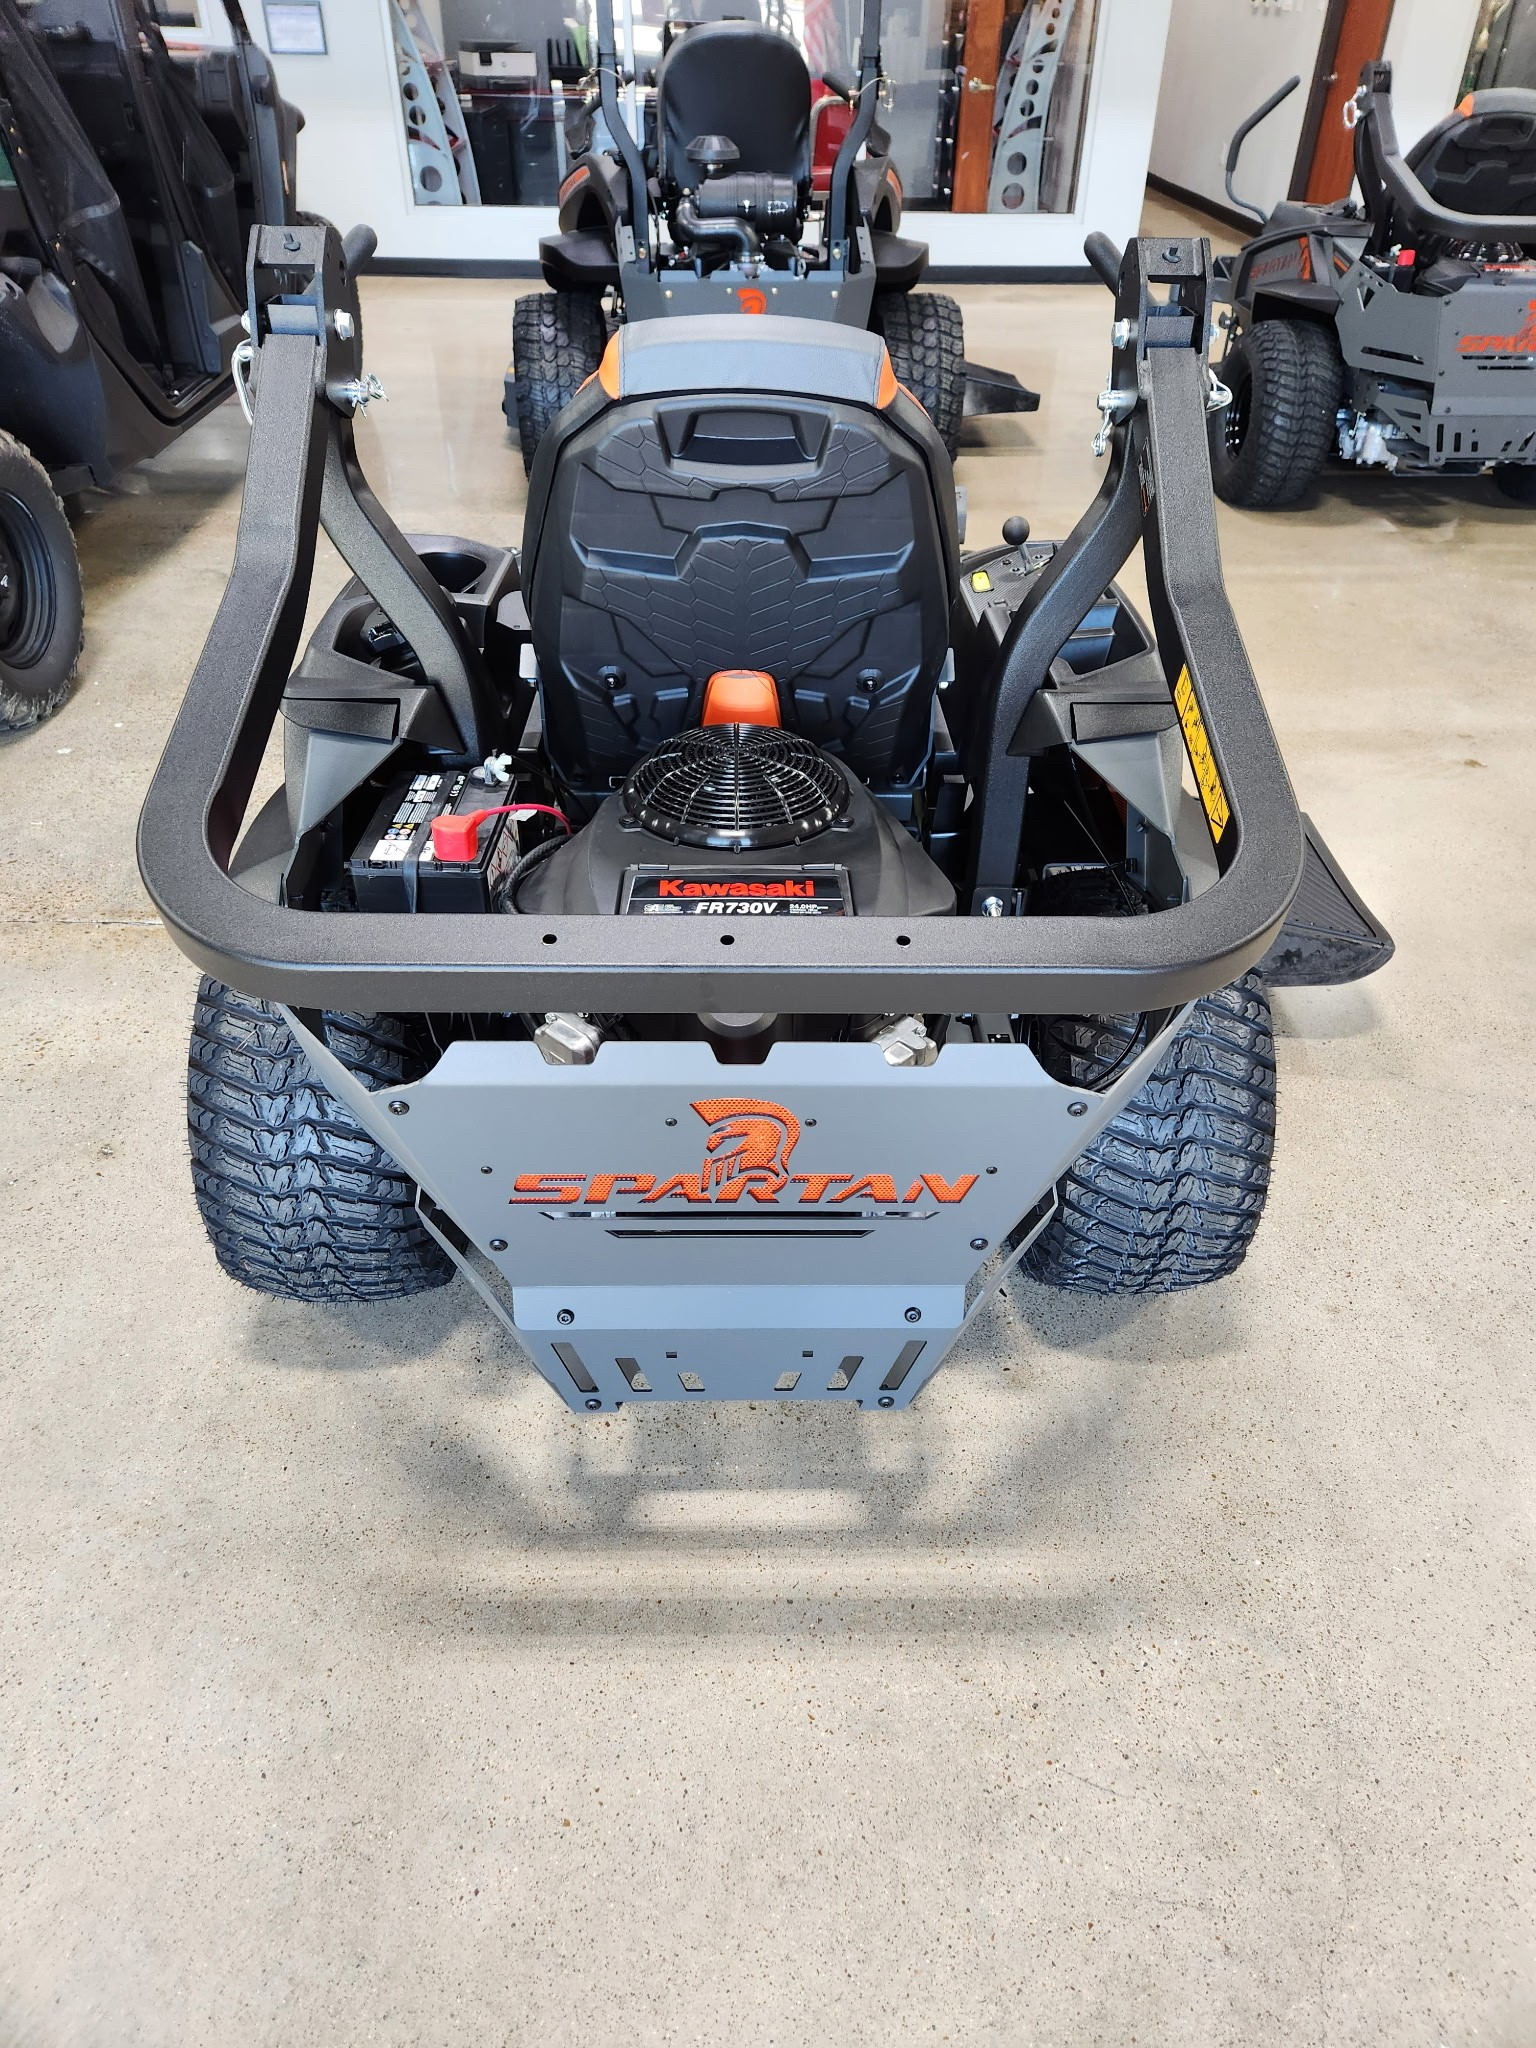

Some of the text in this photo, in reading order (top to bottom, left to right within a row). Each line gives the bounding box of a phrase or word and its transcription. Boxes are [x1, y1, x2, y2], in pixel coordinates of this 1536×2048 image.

[659, 880, 815, 897] Kawasaki
[695, 902, 778, 914] FR730V
[508, 1173, 981, 1205] SPARTAN
